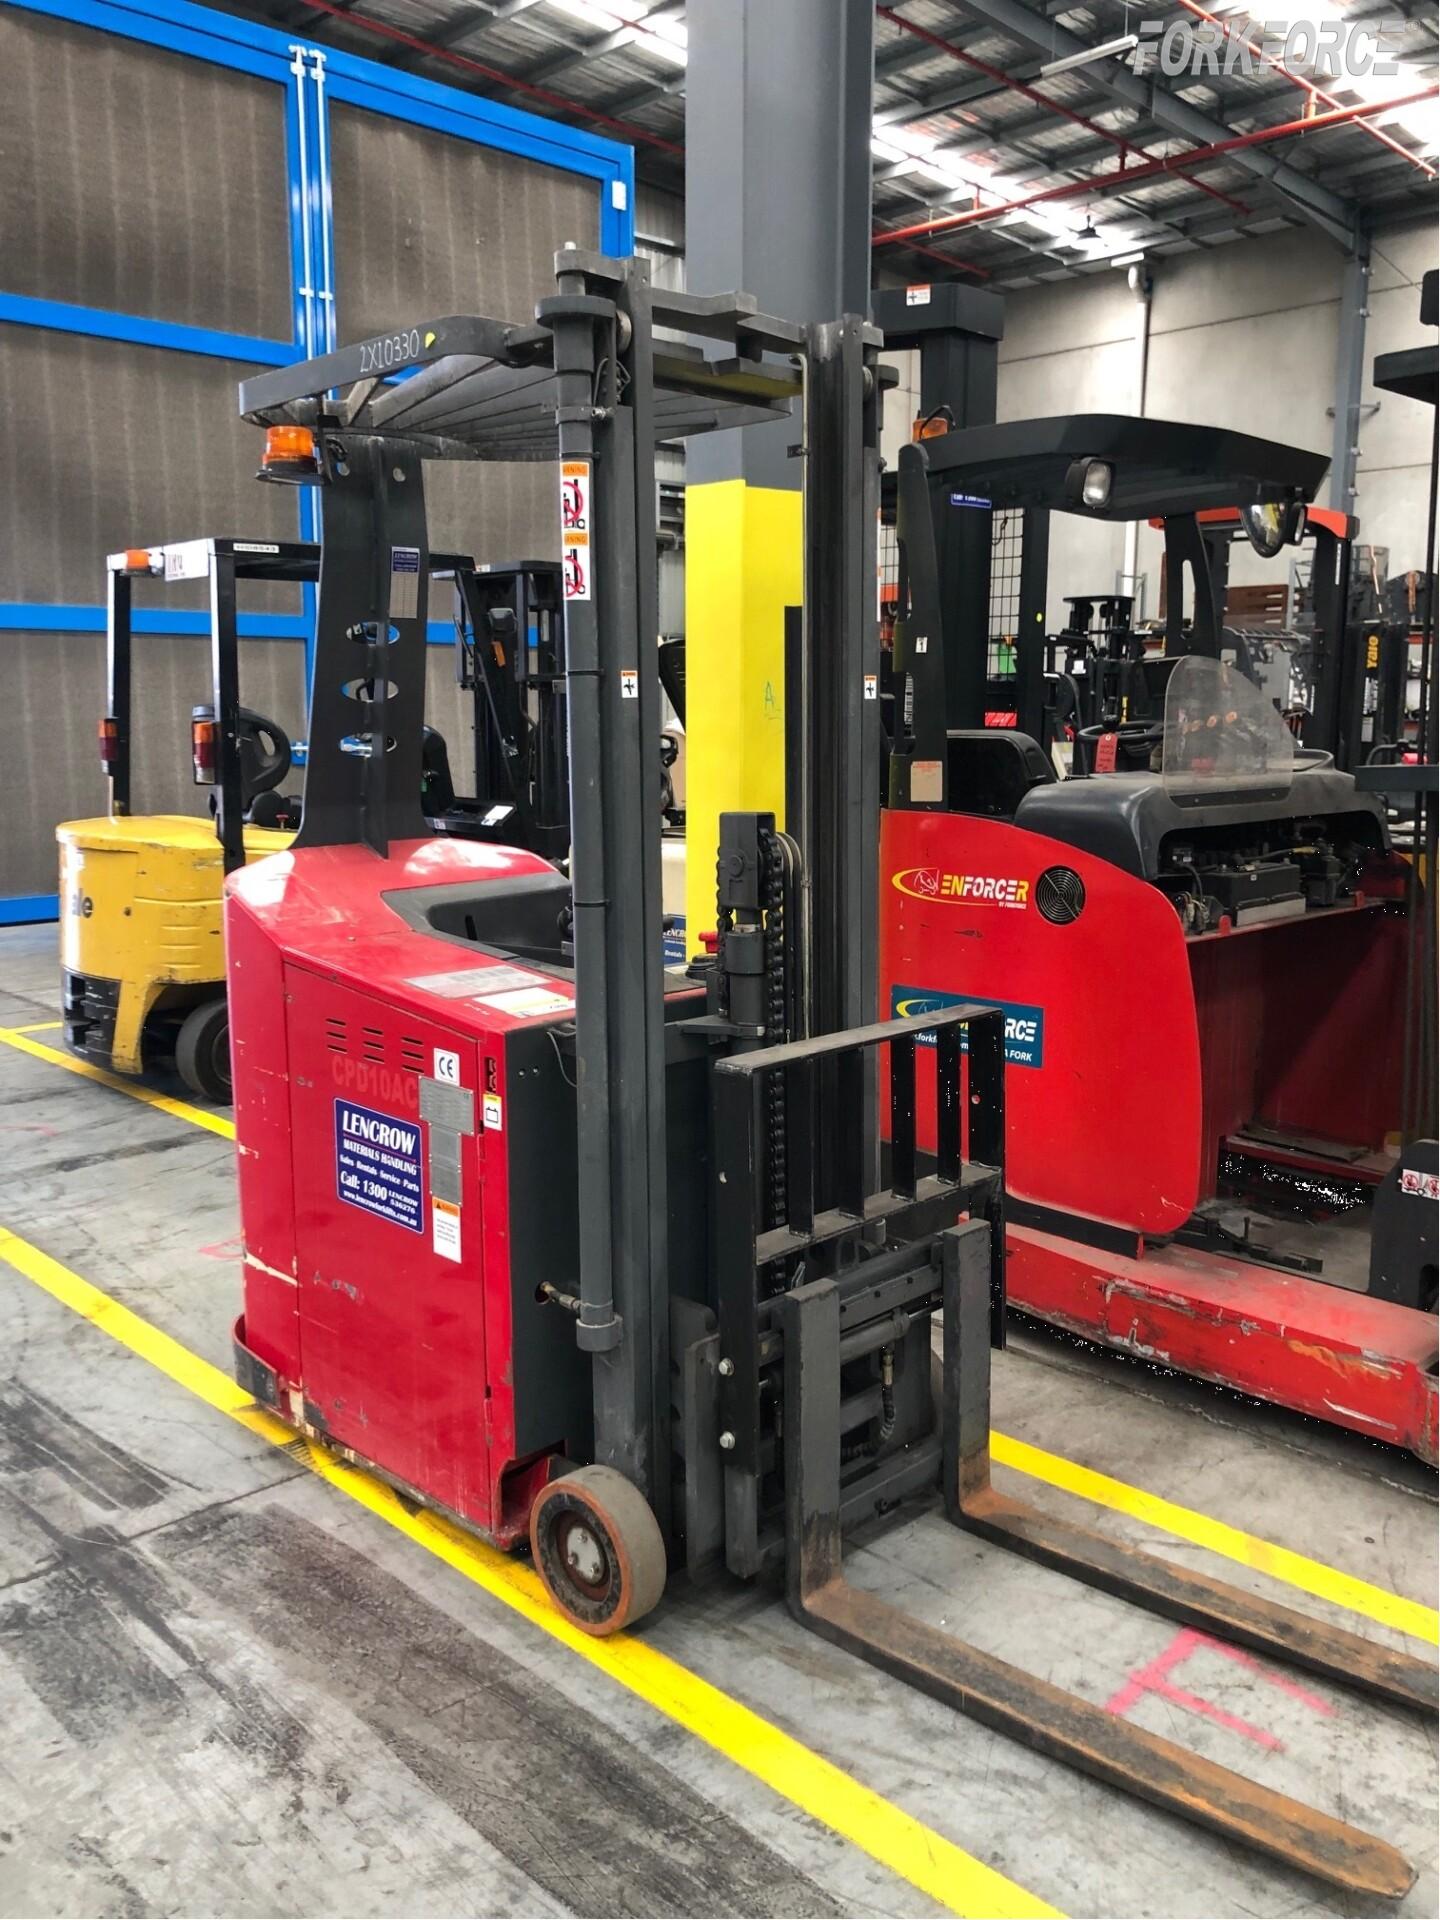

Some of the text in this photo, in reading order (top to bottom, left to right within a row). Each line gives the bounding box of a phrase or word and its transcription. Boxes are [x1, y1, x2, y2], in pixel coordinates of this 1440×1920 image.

[941, 875, 1029, 901] ENFORCER
[1010, 1050, 1032, 1062] FORK
[332, 1055, 418, 1108] CPD10AC
[342, 1110, 416, 1155] LENCROW
[339, 1153, 420, 1193] Sales Rentals Service Parts
[343, 1138, 418, 1176] MATERIALS HANDLING
[340, 1170, 388, 1202] Call: 1300
[388, 1189, 419, 1207] LENCROW
